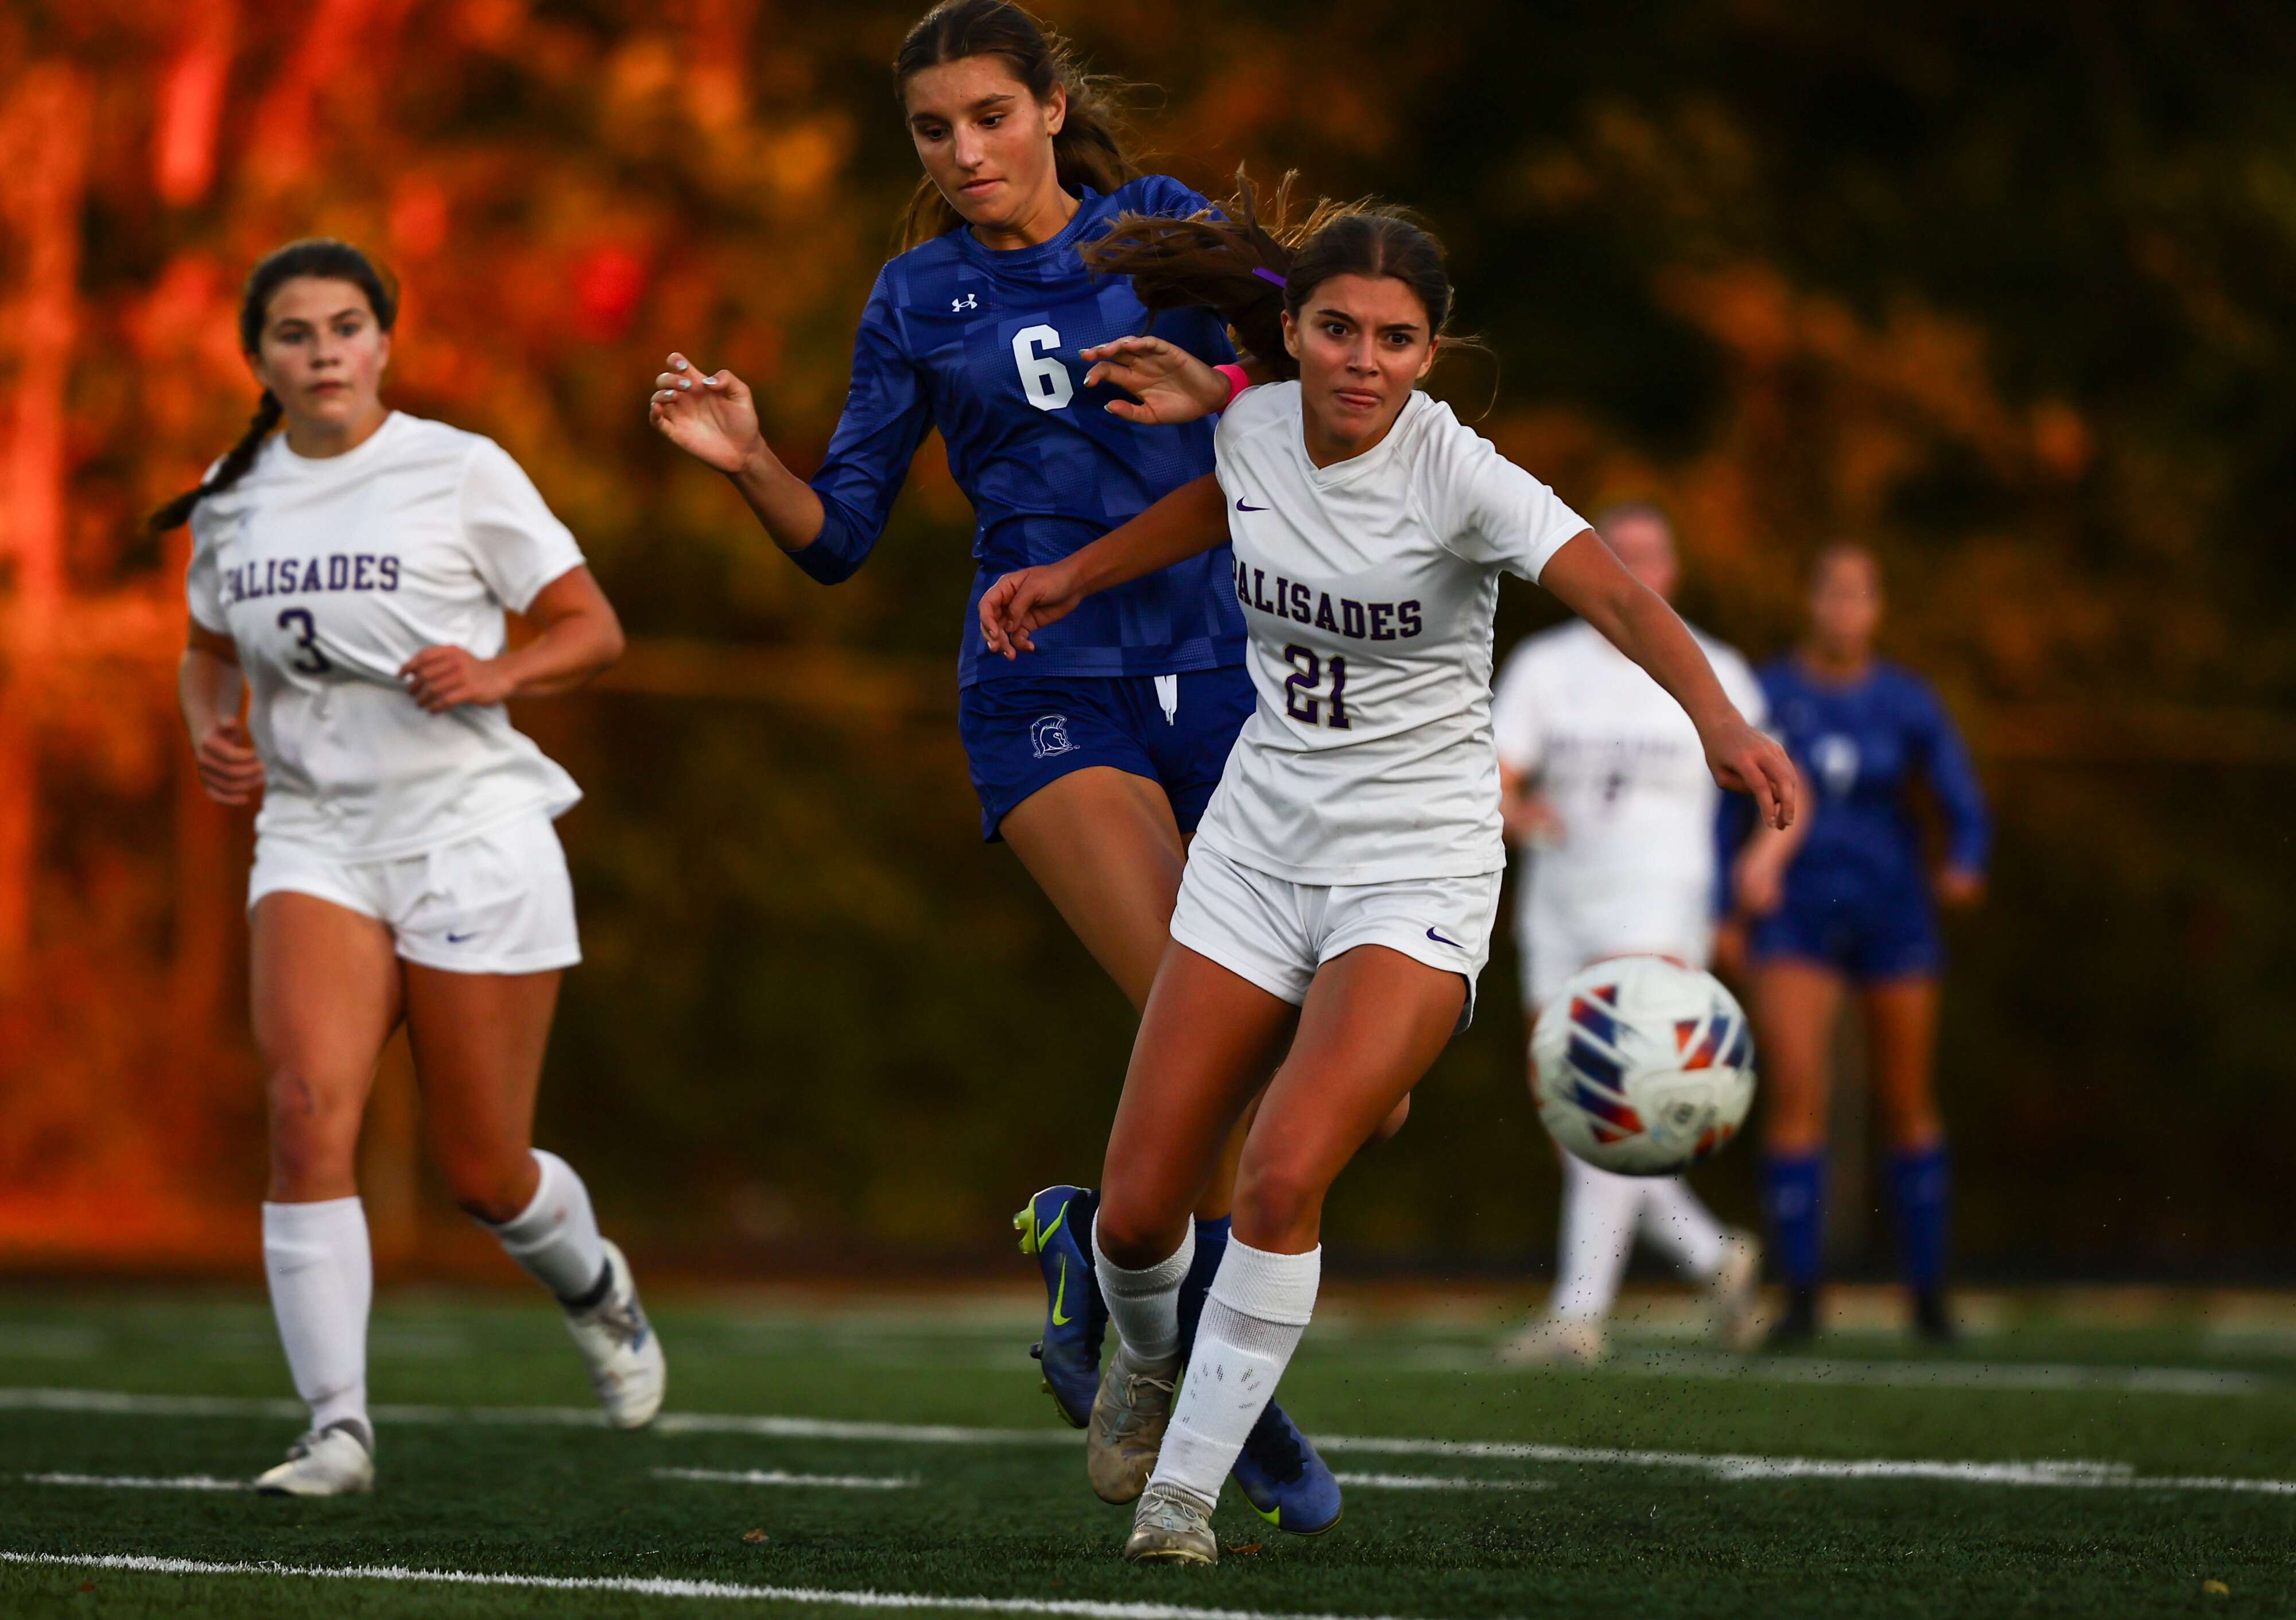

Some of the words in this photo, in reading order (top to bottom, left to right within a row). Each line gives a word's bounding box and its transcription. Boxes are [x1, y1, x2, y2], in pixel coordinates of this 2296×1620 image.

[1012, 324, 1074, 412] 6
[277, 609, 329, 674] 3
[1282, 643, 1351, 731] 21
